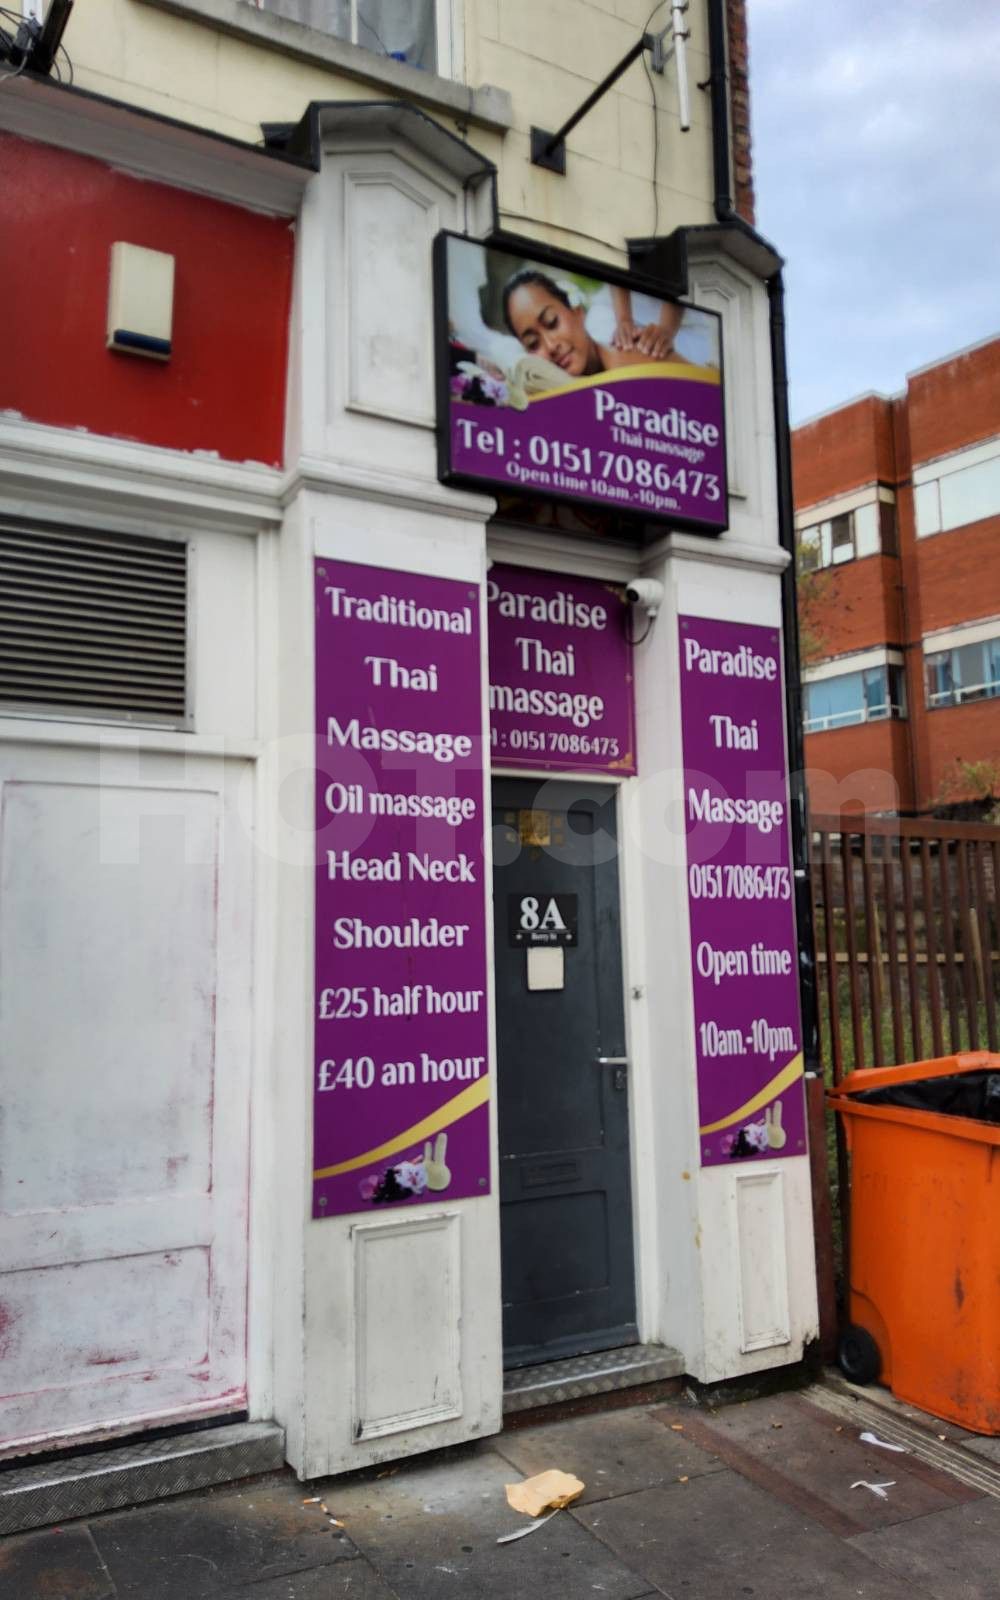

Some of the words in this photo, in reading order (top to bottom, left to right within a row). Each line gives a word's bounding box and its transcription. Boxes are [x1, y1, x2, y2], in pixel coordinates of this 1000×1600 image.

[594, 388, 719, 447] Paradise
[610, 425, 643, 448] Thai
[457, 418, 504, 456] Tel
[529, 435, 592, 475] 0151
[598, 450, 720, 501] 7086473
[506, 460, 551, 483] Open
[553, 471, 588, 491] time
[325, 586, 472, 634] Traditional
[364, 656, 438, 692] Thai
[515, 637, 575, 676] Thai
[684, 638, 777, 681] Paradise
[489, 685, 604, 728] massage
[327, 717, 472, 763] Massage
[510, 729, 546, 751] 0151
[549, 732, 620, 757] 7086473
[709, 714, 758, 751] Thai
[325, 782, 363, 814] Oil
[368, 791, 476, 826] massage
[688, 788, 784, 833] Massage
[327, 850, 401, 881] Head
[407, 852, 477, 882] Neck
[689, 863, 723, 899] 0151
[724, 864, 791, 900] 7086473
[520, 896, 567, 930] 8A
[333, 917, 470, 950] Shoulder
[697, 941, 749, 985] Open
[751, 942, 792, 975] time
[318, 987, 368, 1019] £25
[373, 985, 423, 1017] half
[425, 985, 483, 1014] hour
[317, 1056, 374, 1092] £40
[381, 1061, 415, 1087] an
[420, 1053, 485, 1083] hour
